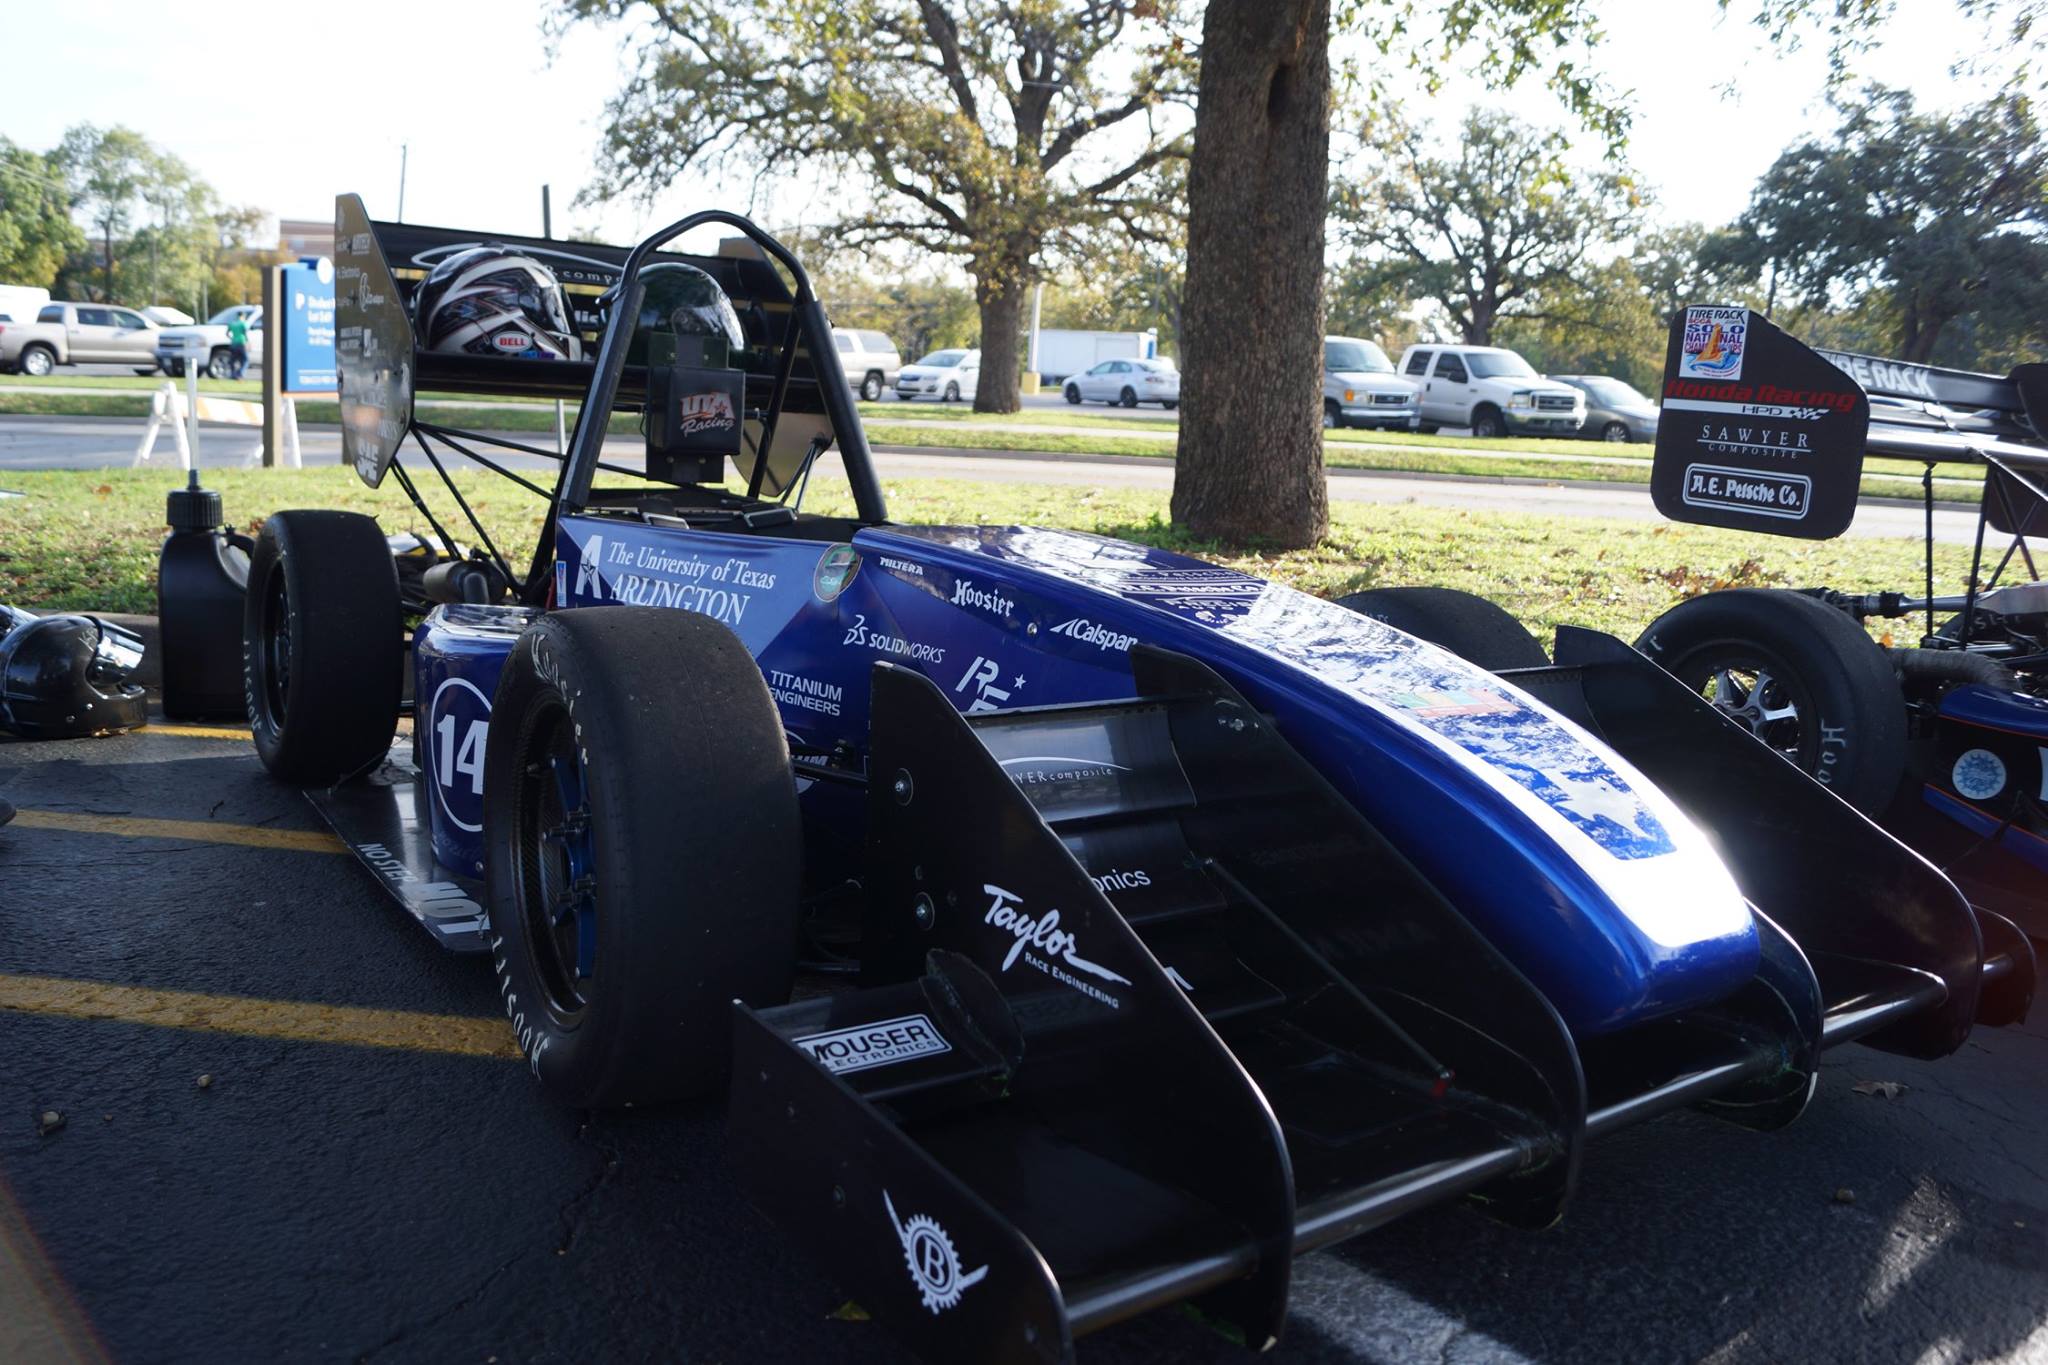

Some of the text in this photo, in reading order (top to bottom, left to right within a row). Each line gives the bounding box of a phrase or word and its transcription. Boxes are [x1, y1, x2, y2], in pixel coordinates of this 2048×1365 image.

[1689, 309, 1745, 324] TIRE RACK
[499, 338, 526, 346] BELL
[1686, 332, 1743, 344] NATINAL
[1664, 378, 1857, 412] Honda Racing
[1872, 361, 1937, 399] RACK
[1742, 405, 1783, 416] HPD
[681, 417, 735, 438] Racing
[1702, 424, 1809, 448] SAWYER
[1708, 442, 1799, 459] COMPOSITE
[607, 541, 777, 590] The University of Texas
[610, 573, 751, 625] ARLINGTON
[950, 579, 1014, 617] Hoosier
[868, 633, 946, 664] SOLIDWORKS
[770, 686, 841, 717] ENGINEERS
[771, 670, 843, 702] TITANIUM
[436, 713, 490, 796] 14
[356, 842, 419, 883] NO STEP
[982, 883, 1133, 985] Taylor
[1025, 951, 1120, 1010] RACE ENGINEERING
[814, 1025, 929, 1064] MOUSER
[830, 1039, 940, 1068] ECTRONICS
